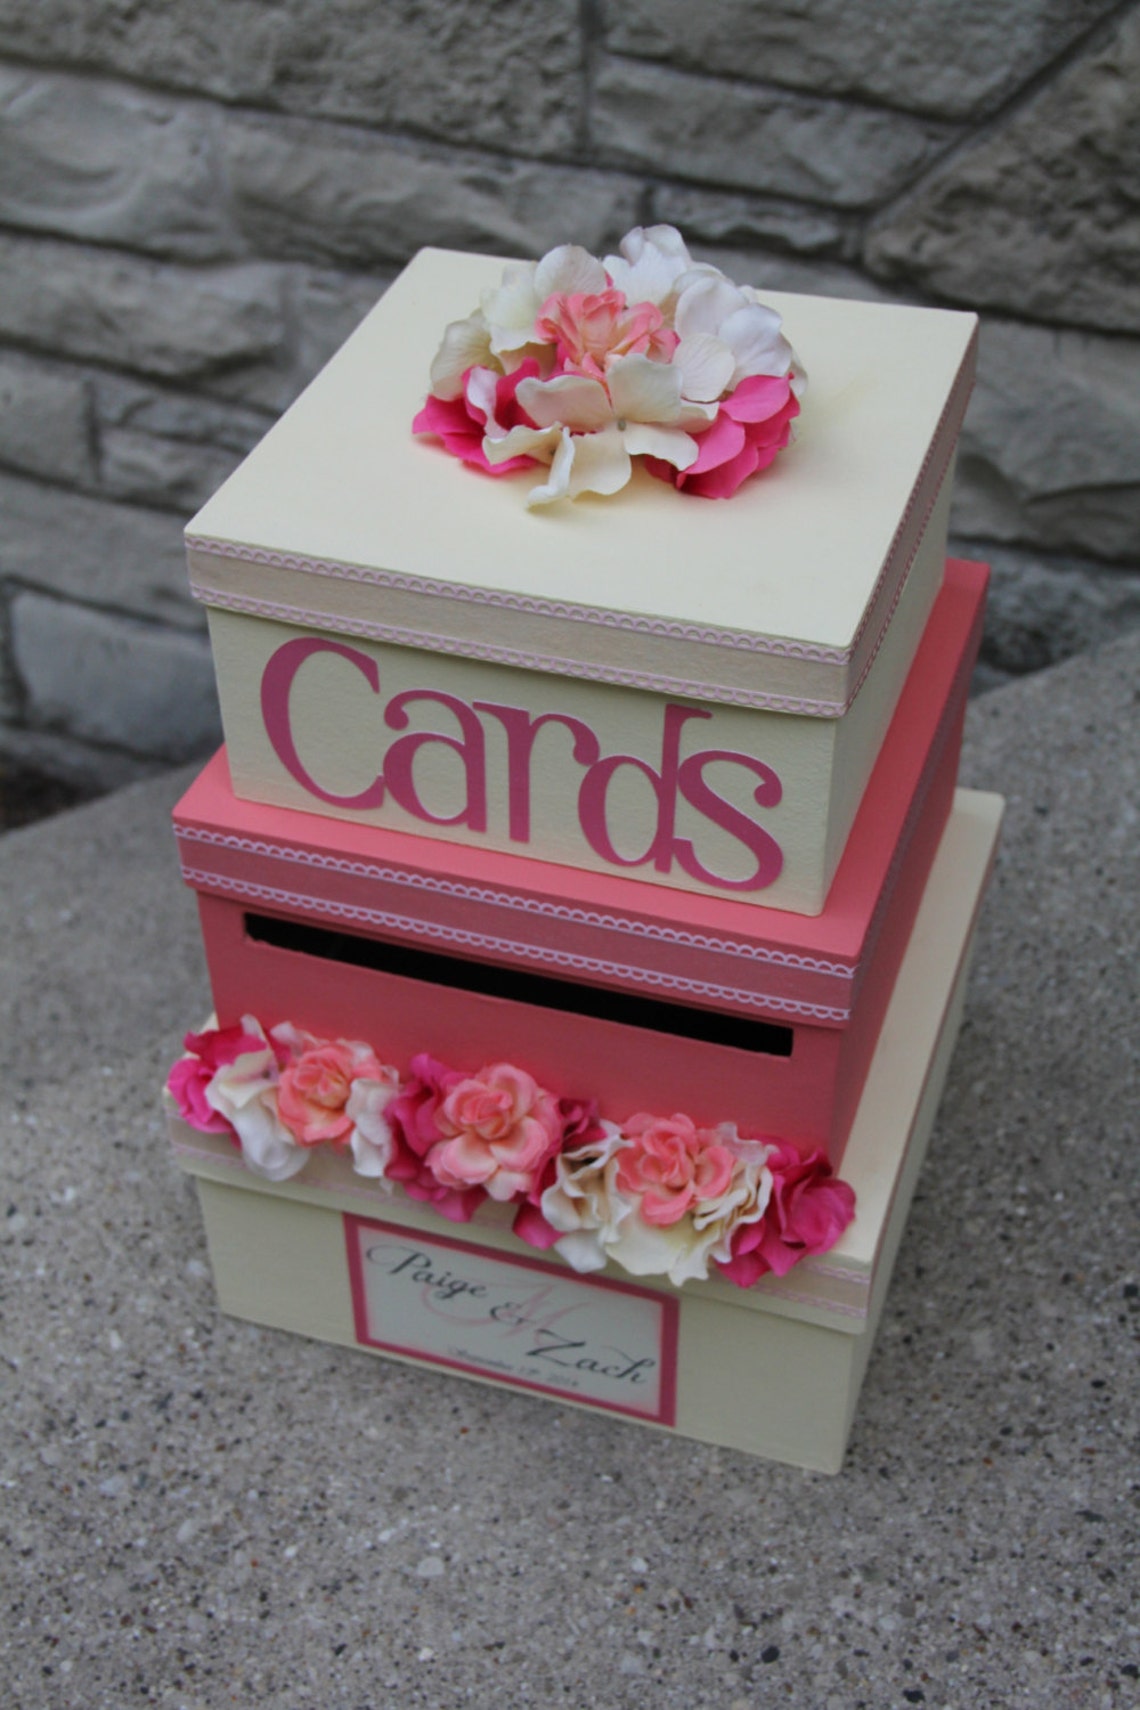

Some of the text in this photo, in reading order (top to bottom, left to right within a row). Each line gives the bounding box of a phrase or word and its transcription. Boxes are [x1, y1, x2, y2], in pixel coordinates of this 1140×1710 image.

[260, 636, 784, 892] Cards
[366, 1244, 488, 1300] Paige
[489, 1301, 537, 1327] &
[525, 1328, 656, 1384] Zach
